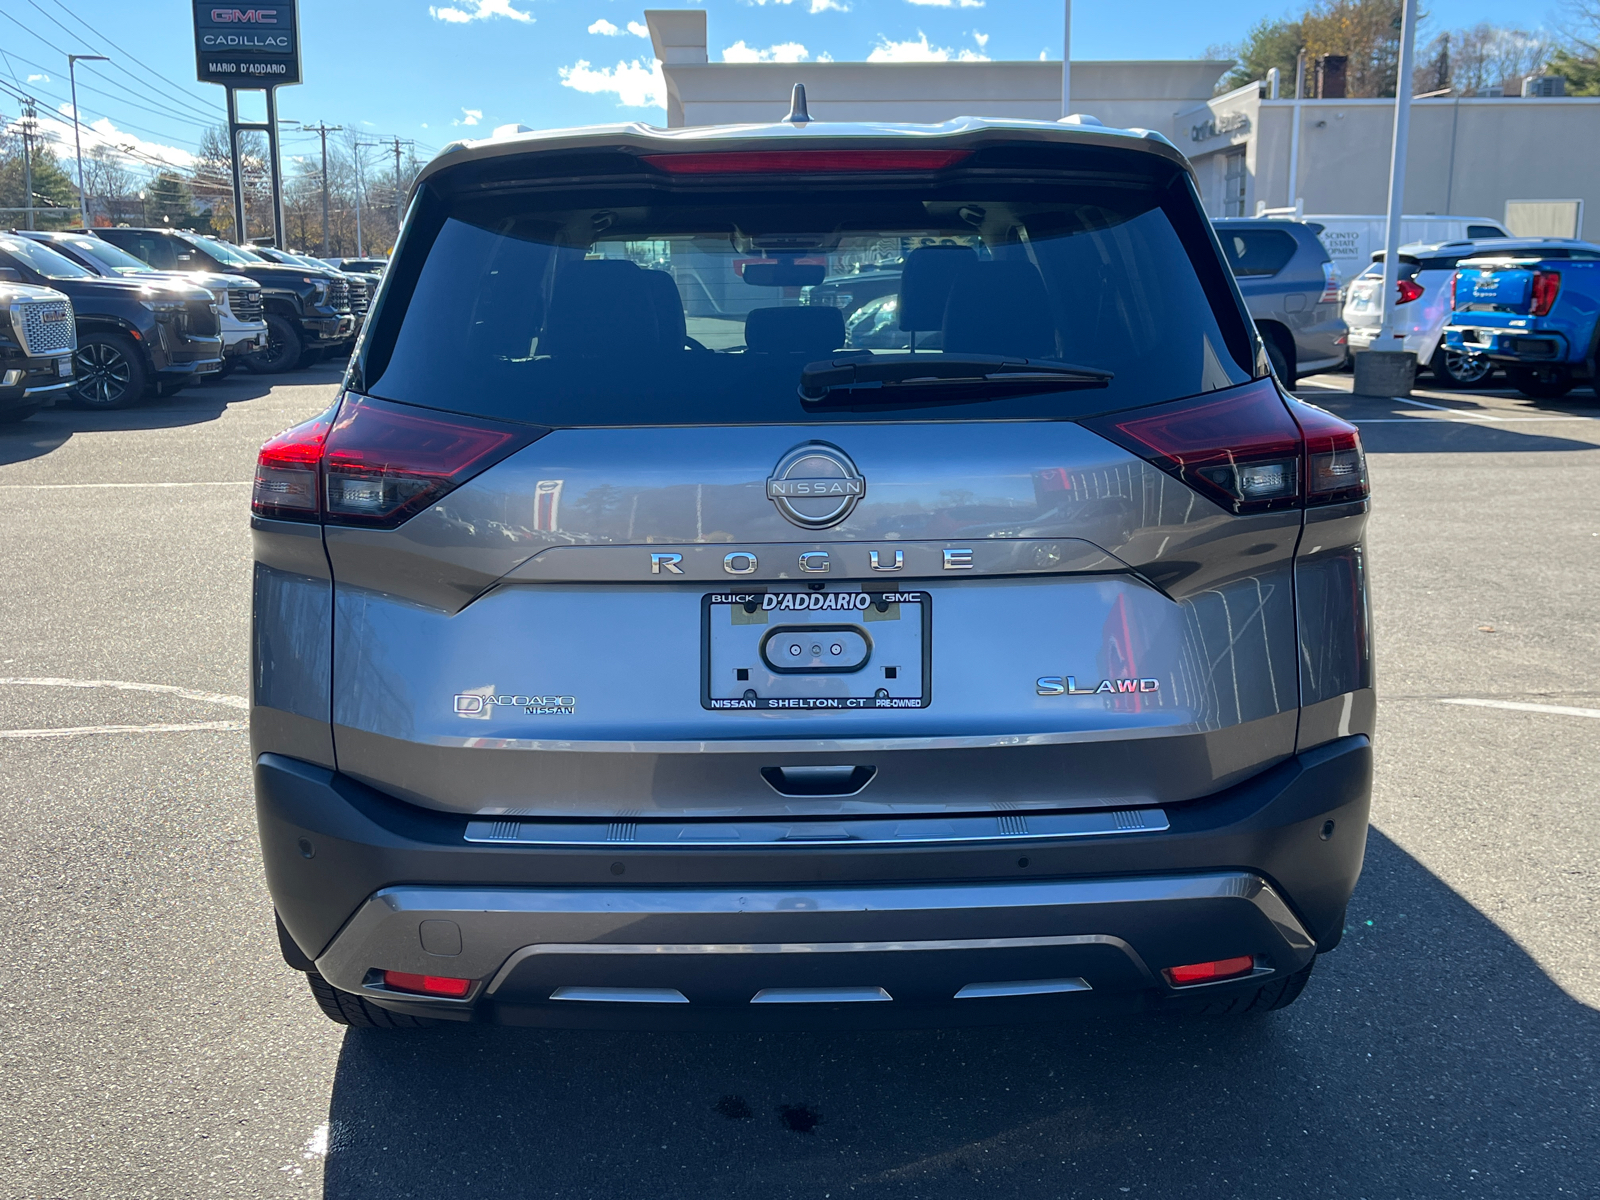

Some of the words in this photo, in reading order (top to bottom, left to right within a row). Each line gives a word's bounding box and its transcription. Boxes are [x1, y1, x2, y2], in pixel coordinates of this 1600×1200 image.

[211, 9, 277, 23] GMC
[203, 35, 288, 46] CADILLAC
[209, 62, 236, 73] MARIO
[240, 63, 286, 74] D'ADDARIO
[772, 481, 860, 494] NISSAN
[650, 548, 974, 575] ROGUE
[711, 594, 755, 602] BUICK
[762, 593, 871, 610] D'ADDARIO
[882, 593, 921, 602] GMC
[1036, 676, 1095, 695] SL
[1095, 678, 1160, 694] AWD
[711, 700, 756, 708] NISSAN
[768, 699, 842, 708] SHELTON,
[846, 699, 866, 707] CT
[876, 699, 922, 707] PRE-OWNED
